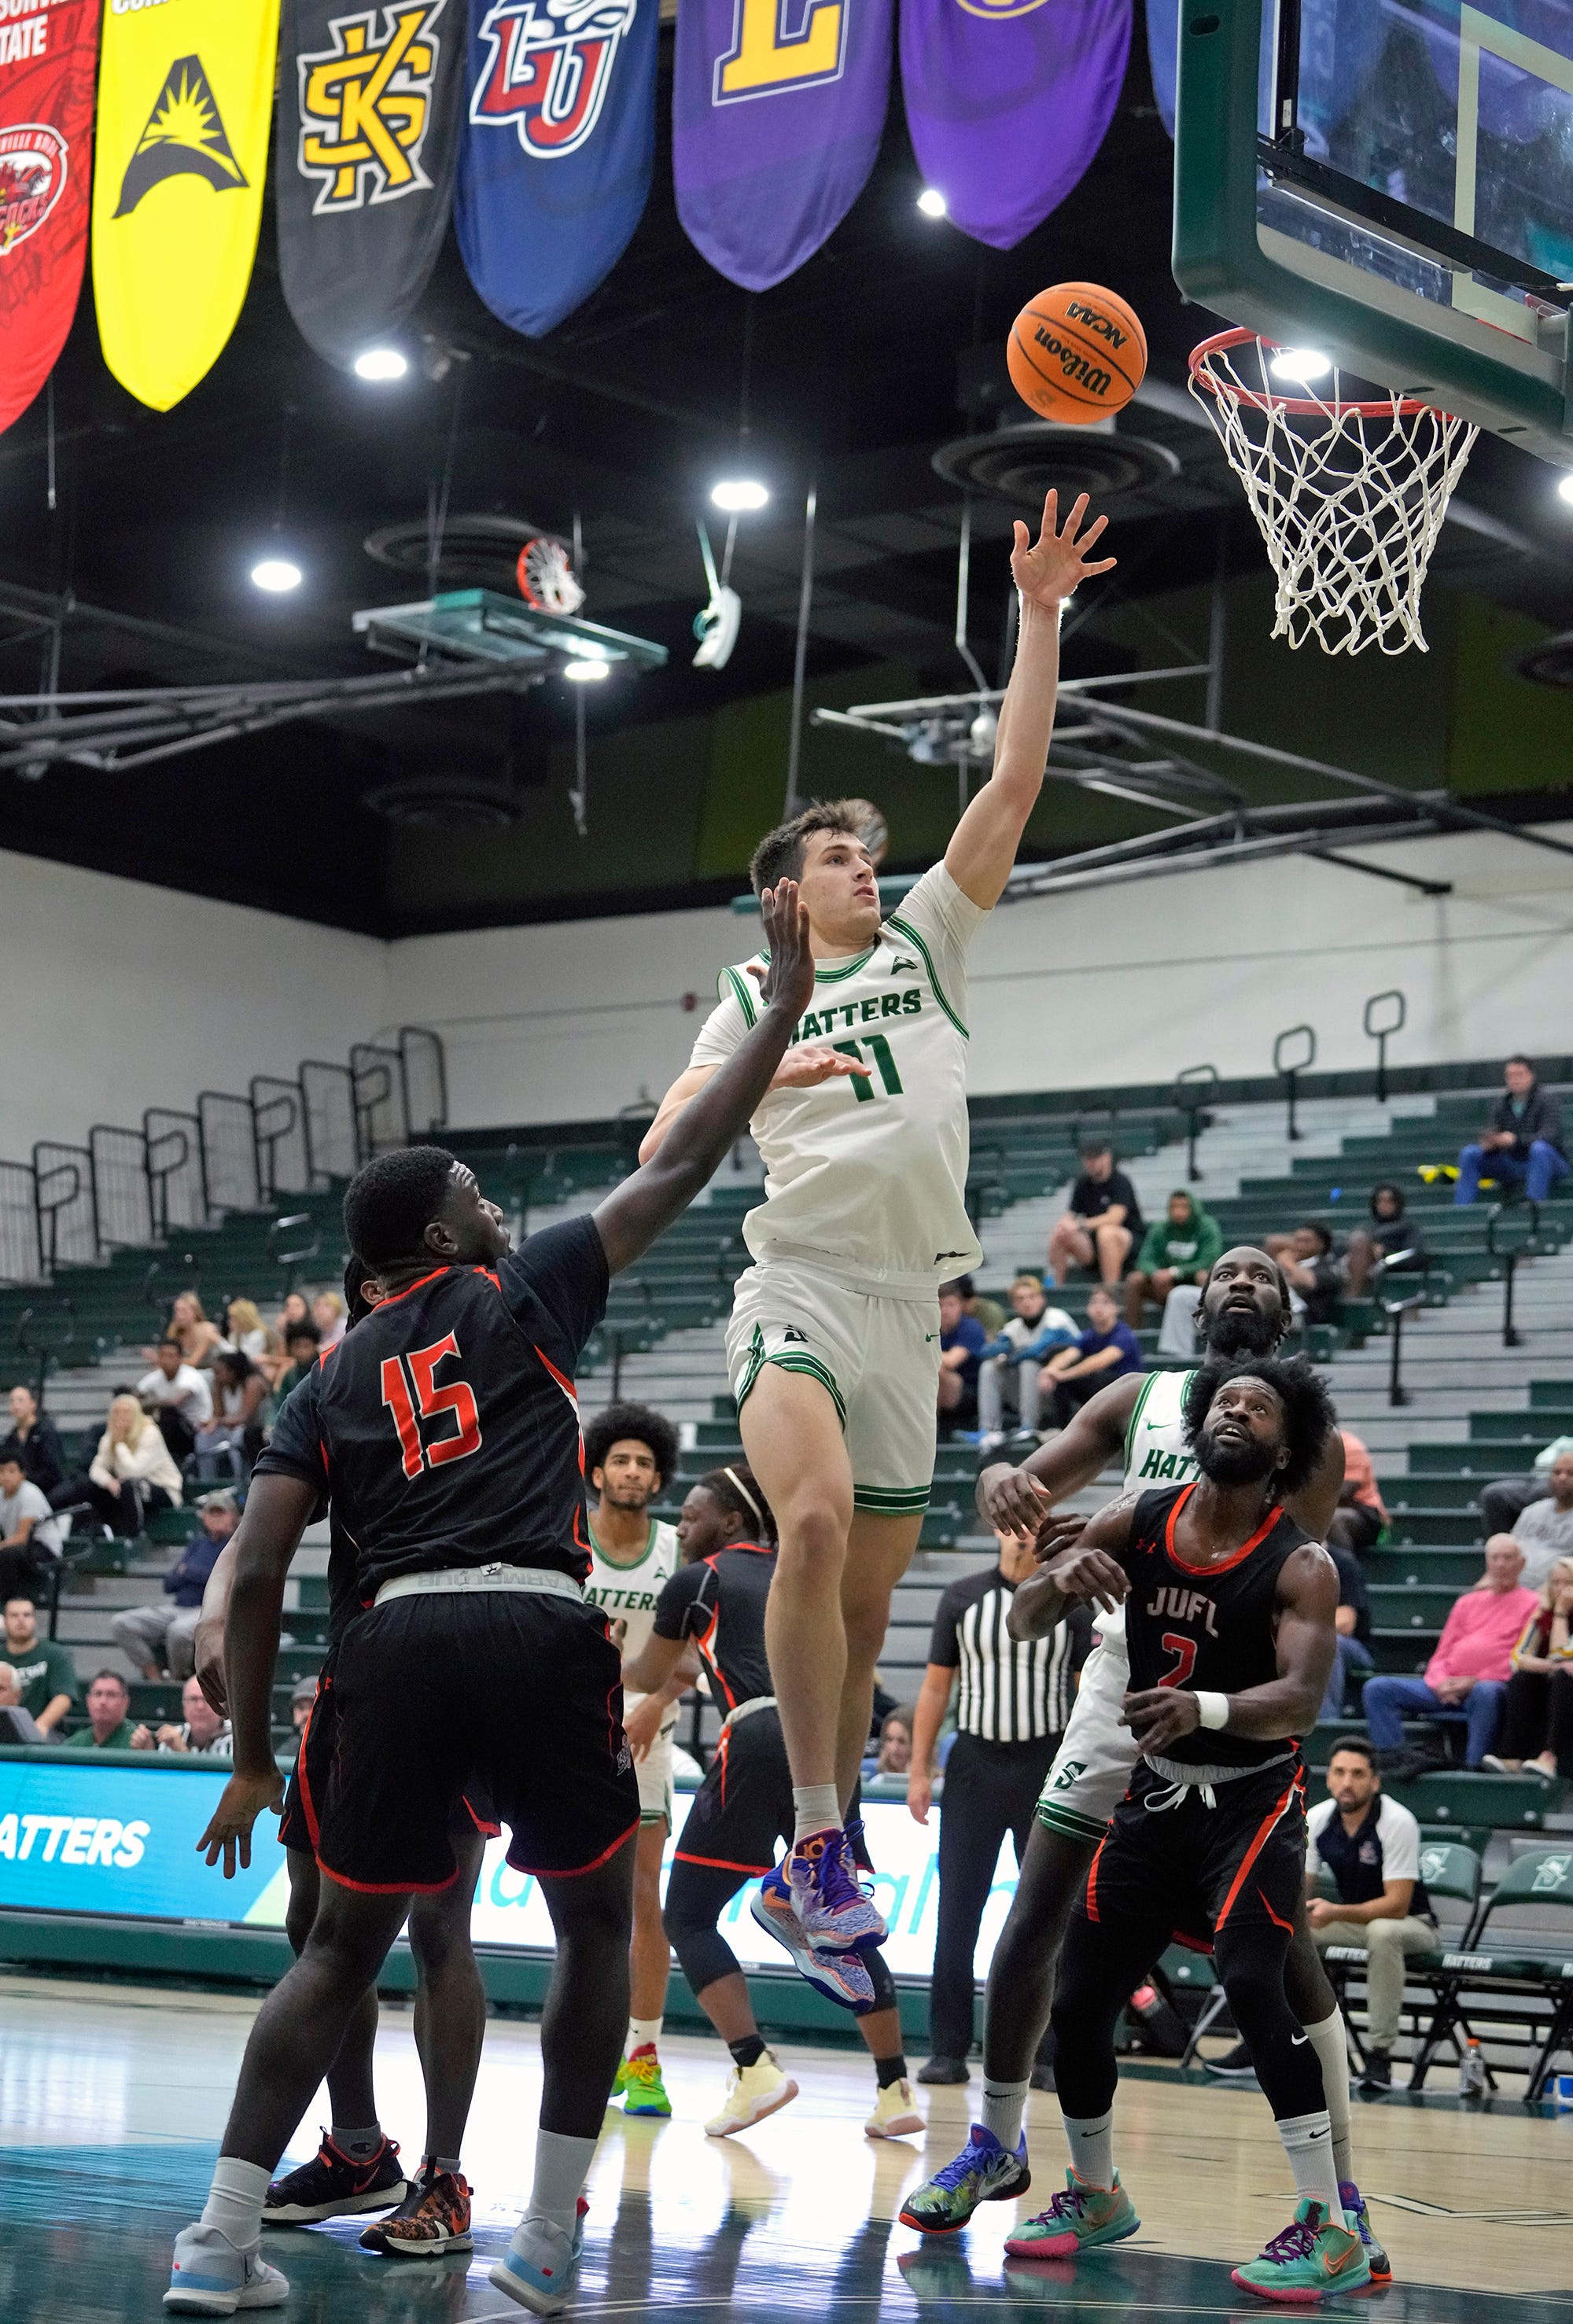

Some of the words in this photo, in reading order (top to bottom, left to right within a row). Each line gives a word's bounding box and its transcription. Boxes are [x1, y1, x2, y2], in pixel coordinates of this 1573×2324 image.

[1065, 300, 1127, 350] NCAA
[1034, 325, 1111, 396] Wilson
[832, 1033, 904, 1102] 11
[380, 1328, 483, 1481] 15
[580, 1585, 658, 1611] ATTER
[1147, 1586, 1218, 1638] JUFL
[1157, 1632, 1198, 1689] 2
[0, 1813, 151, 1868] ATTERS
